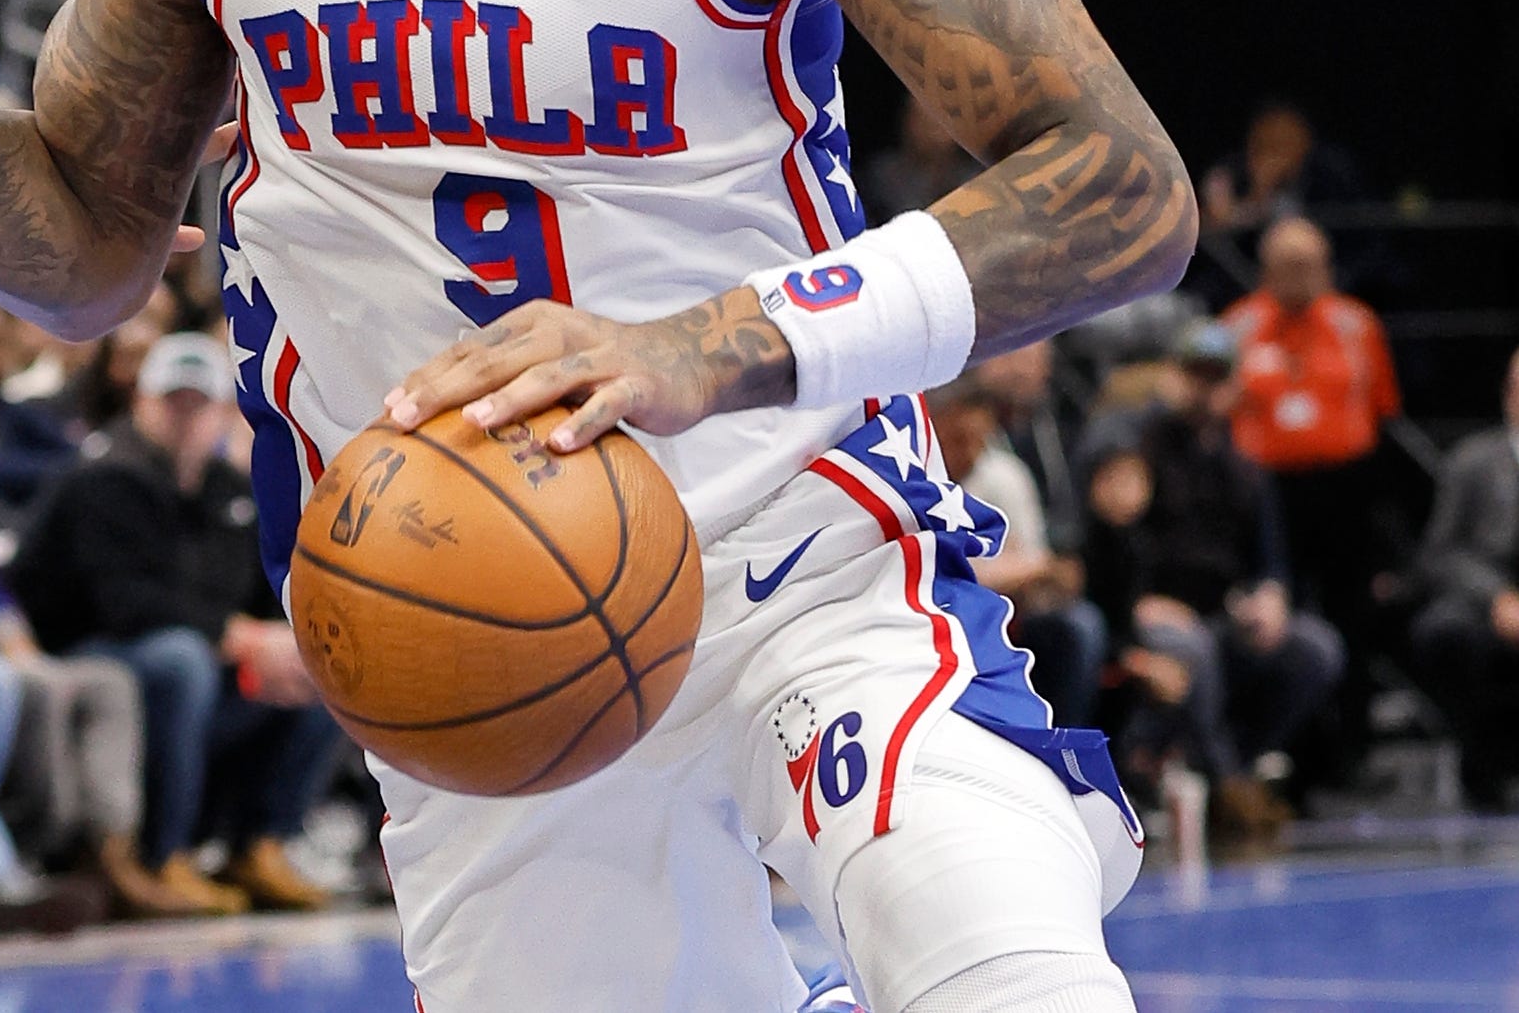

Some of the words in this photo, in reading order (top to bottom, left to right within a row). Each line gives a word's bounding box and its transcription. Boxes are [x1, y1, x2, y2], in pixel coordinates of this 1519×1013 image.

[433, 172, 573, 329] 9
[783, 264, 864, 314] 9
[773, 693, 868, 846] 76
